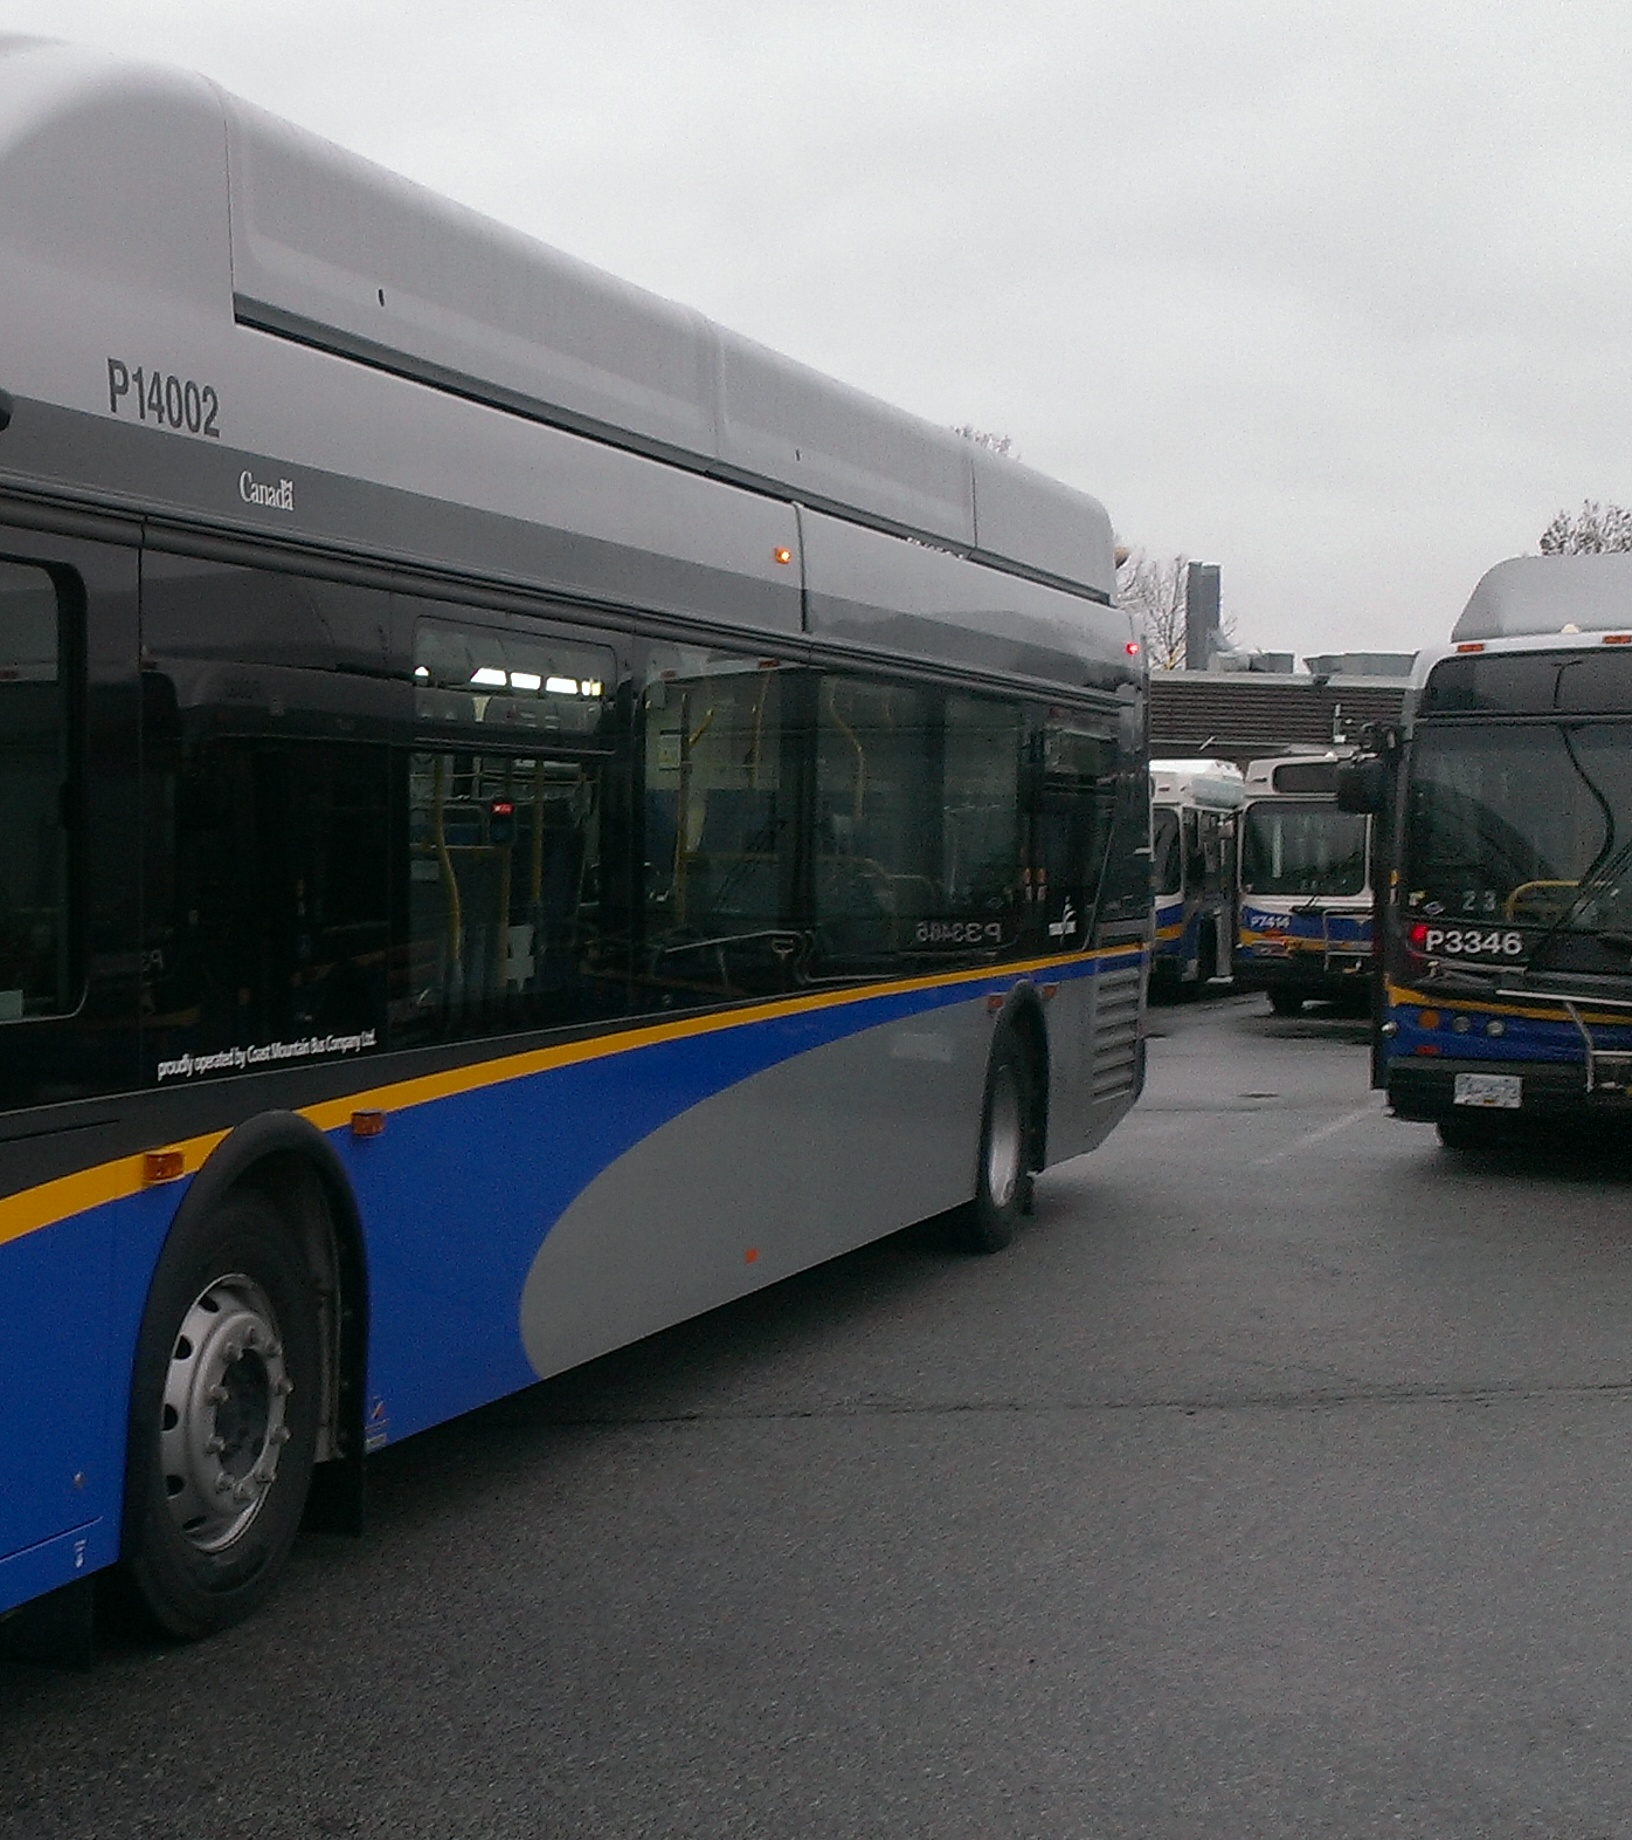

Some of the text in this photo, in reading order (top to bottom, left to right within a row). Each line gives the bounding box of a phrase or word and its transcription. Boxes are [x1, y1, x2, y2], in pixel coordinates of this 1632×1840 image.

[108, 357, 221, 438] P14002
[239, 470, 294, 511] Canada
[1425, 929, 1524, 956] P3346
[157, 1053, 193, 1082] proudly
[194, 1046, 234, 1075] operated
[234, 1047, 247, 1069] by
[247, 1044, 270, 1063] Coast
[271, 1037, 310, 1060] Mountain
[310, 1036, 326, 1054] Bus
[326, 1034, 361, 1054] Company
